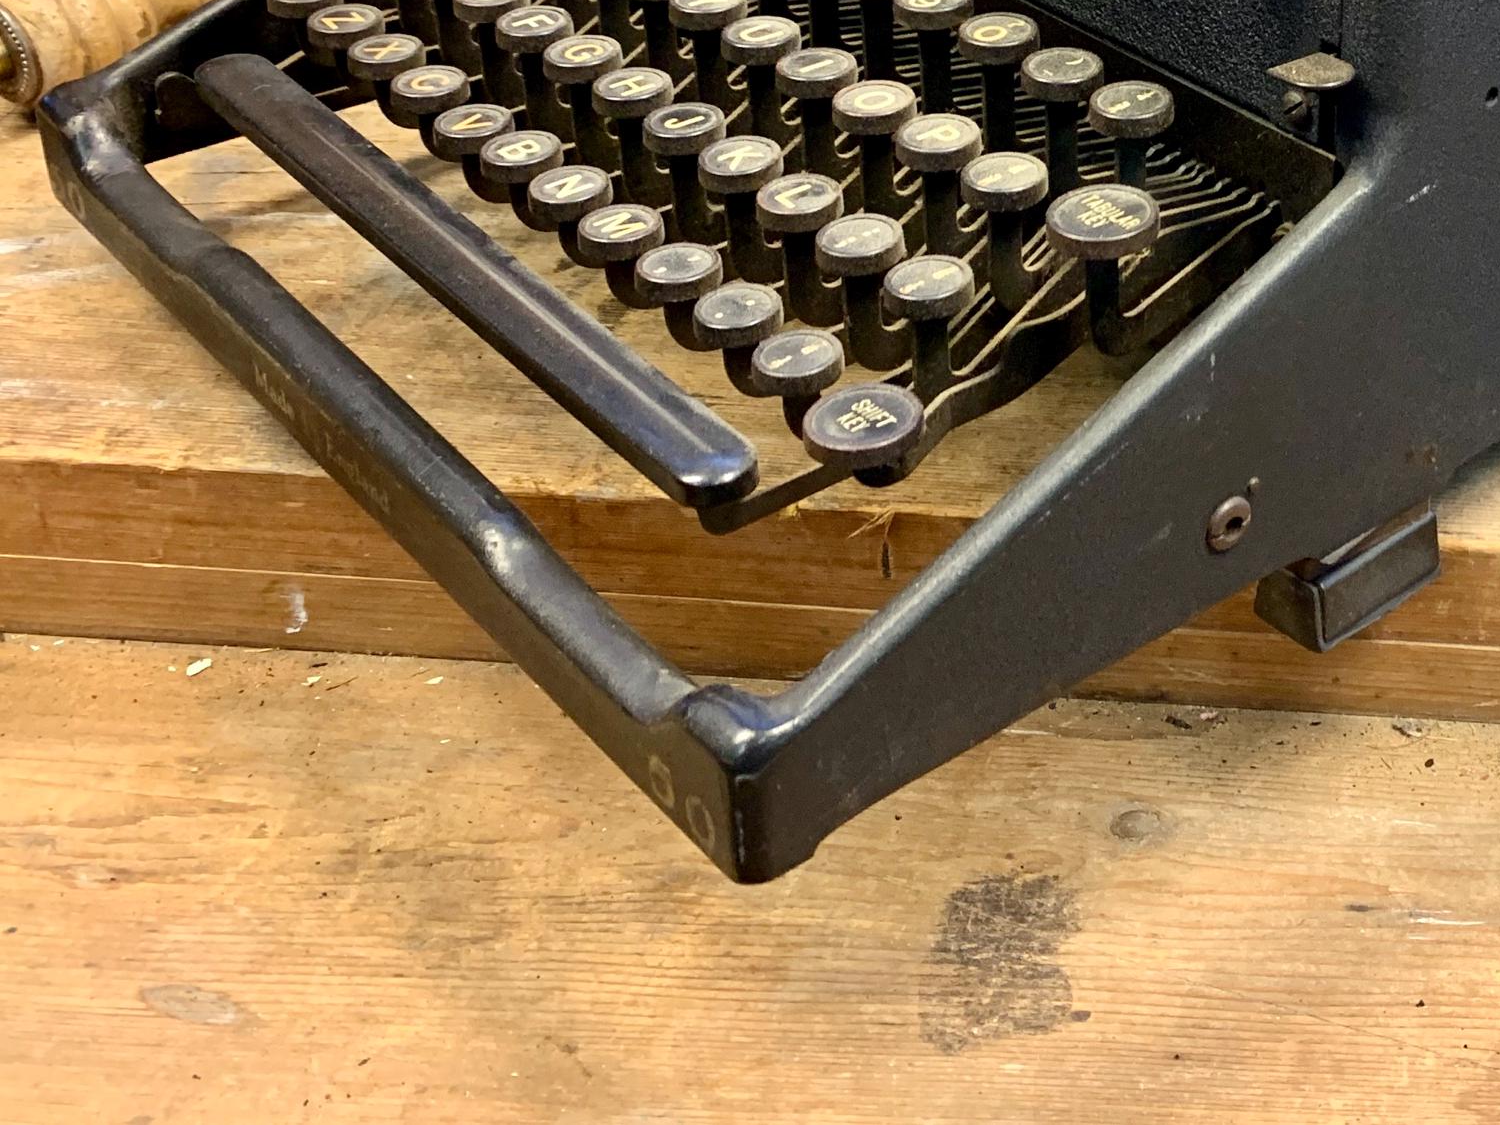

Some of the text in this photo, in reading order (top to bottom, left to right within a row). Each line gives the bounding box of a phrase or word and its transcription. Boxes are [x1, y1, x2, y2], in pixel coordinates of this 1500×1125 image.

[320, 11, 365, 30] Z
[511, 14, 556, 29] F
[738, 24, 785, 42] U
[363, 40, 408, 60] X
[564, 42, 605, 62] G
[800, 59, 834, 74] I
[411, 73, 450, 91] C
[608, 74, 657, 97] H
[854, 90, 896, 110] O
[451, 113, 494, 132] V
[663, 115, 706, 130] J
[915, 124, 961, 142] P
[496, 138, 542, 161] B
[716, 145, 766, 172] K
[543, 173, 596, 200] N
[774, 183, 814, 209] L
[1076, 210, 1110, 229] KEY
[1080, 194, 1141, 231] TABULAR
[592, 211, 648, 240] M
[835, 410, 871, 433] KEY
[850, 398, 898, 428] SHIFT
